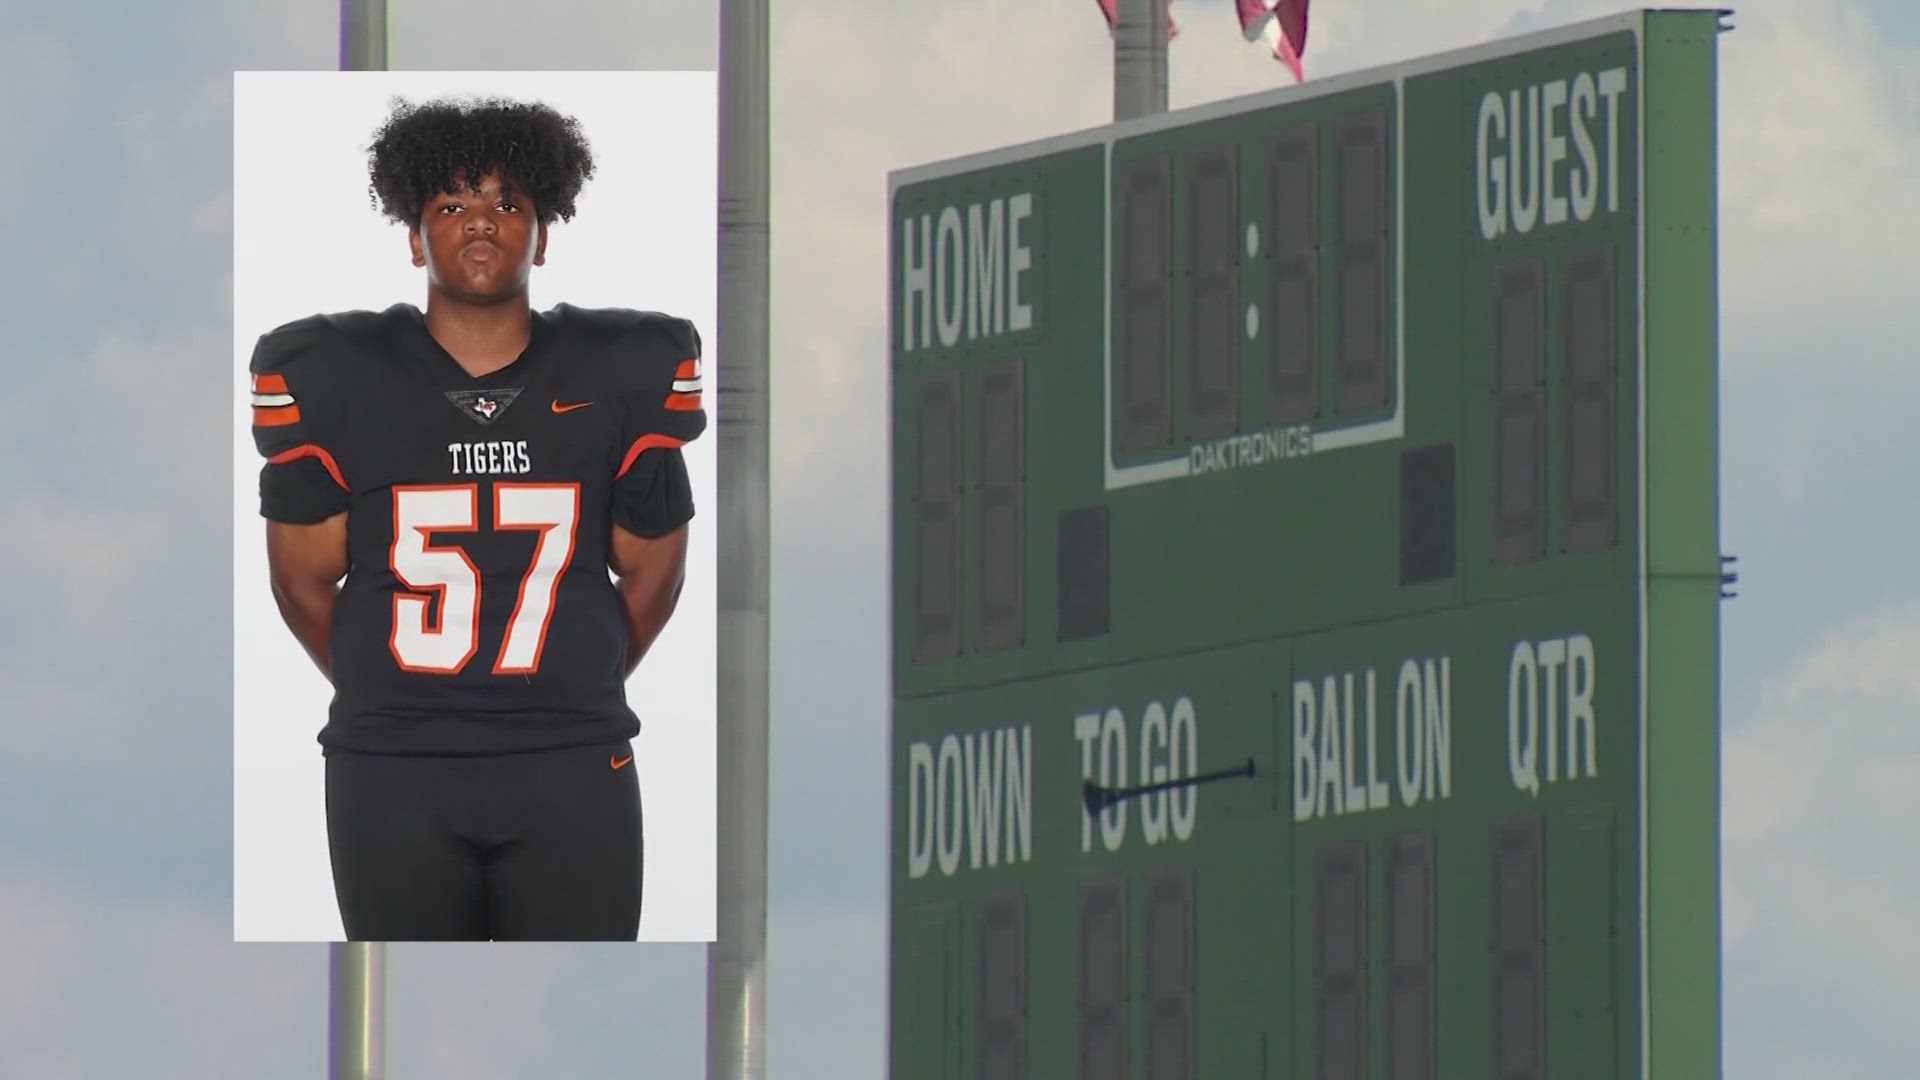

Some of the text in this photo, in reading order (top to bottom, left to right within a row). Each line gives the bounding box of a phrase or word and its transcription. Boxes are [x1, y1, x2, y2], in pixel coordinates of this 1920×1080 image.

[1476, 67, 1628, 240] GUEST
[902, 193, 1034, 352] HOME
[448, 440, 531, 474] TIGERS
[1190, 425, 1313, 477] DAKTRONICS
[389, 482, 581, 674] 57
[1075, 696, 1198, 853] TO GO
[1293, 656, 1451, 823] BALL ON
[1507, 634, 1598, 797] QTR
[908, 725, 1032, 879] DOWN
